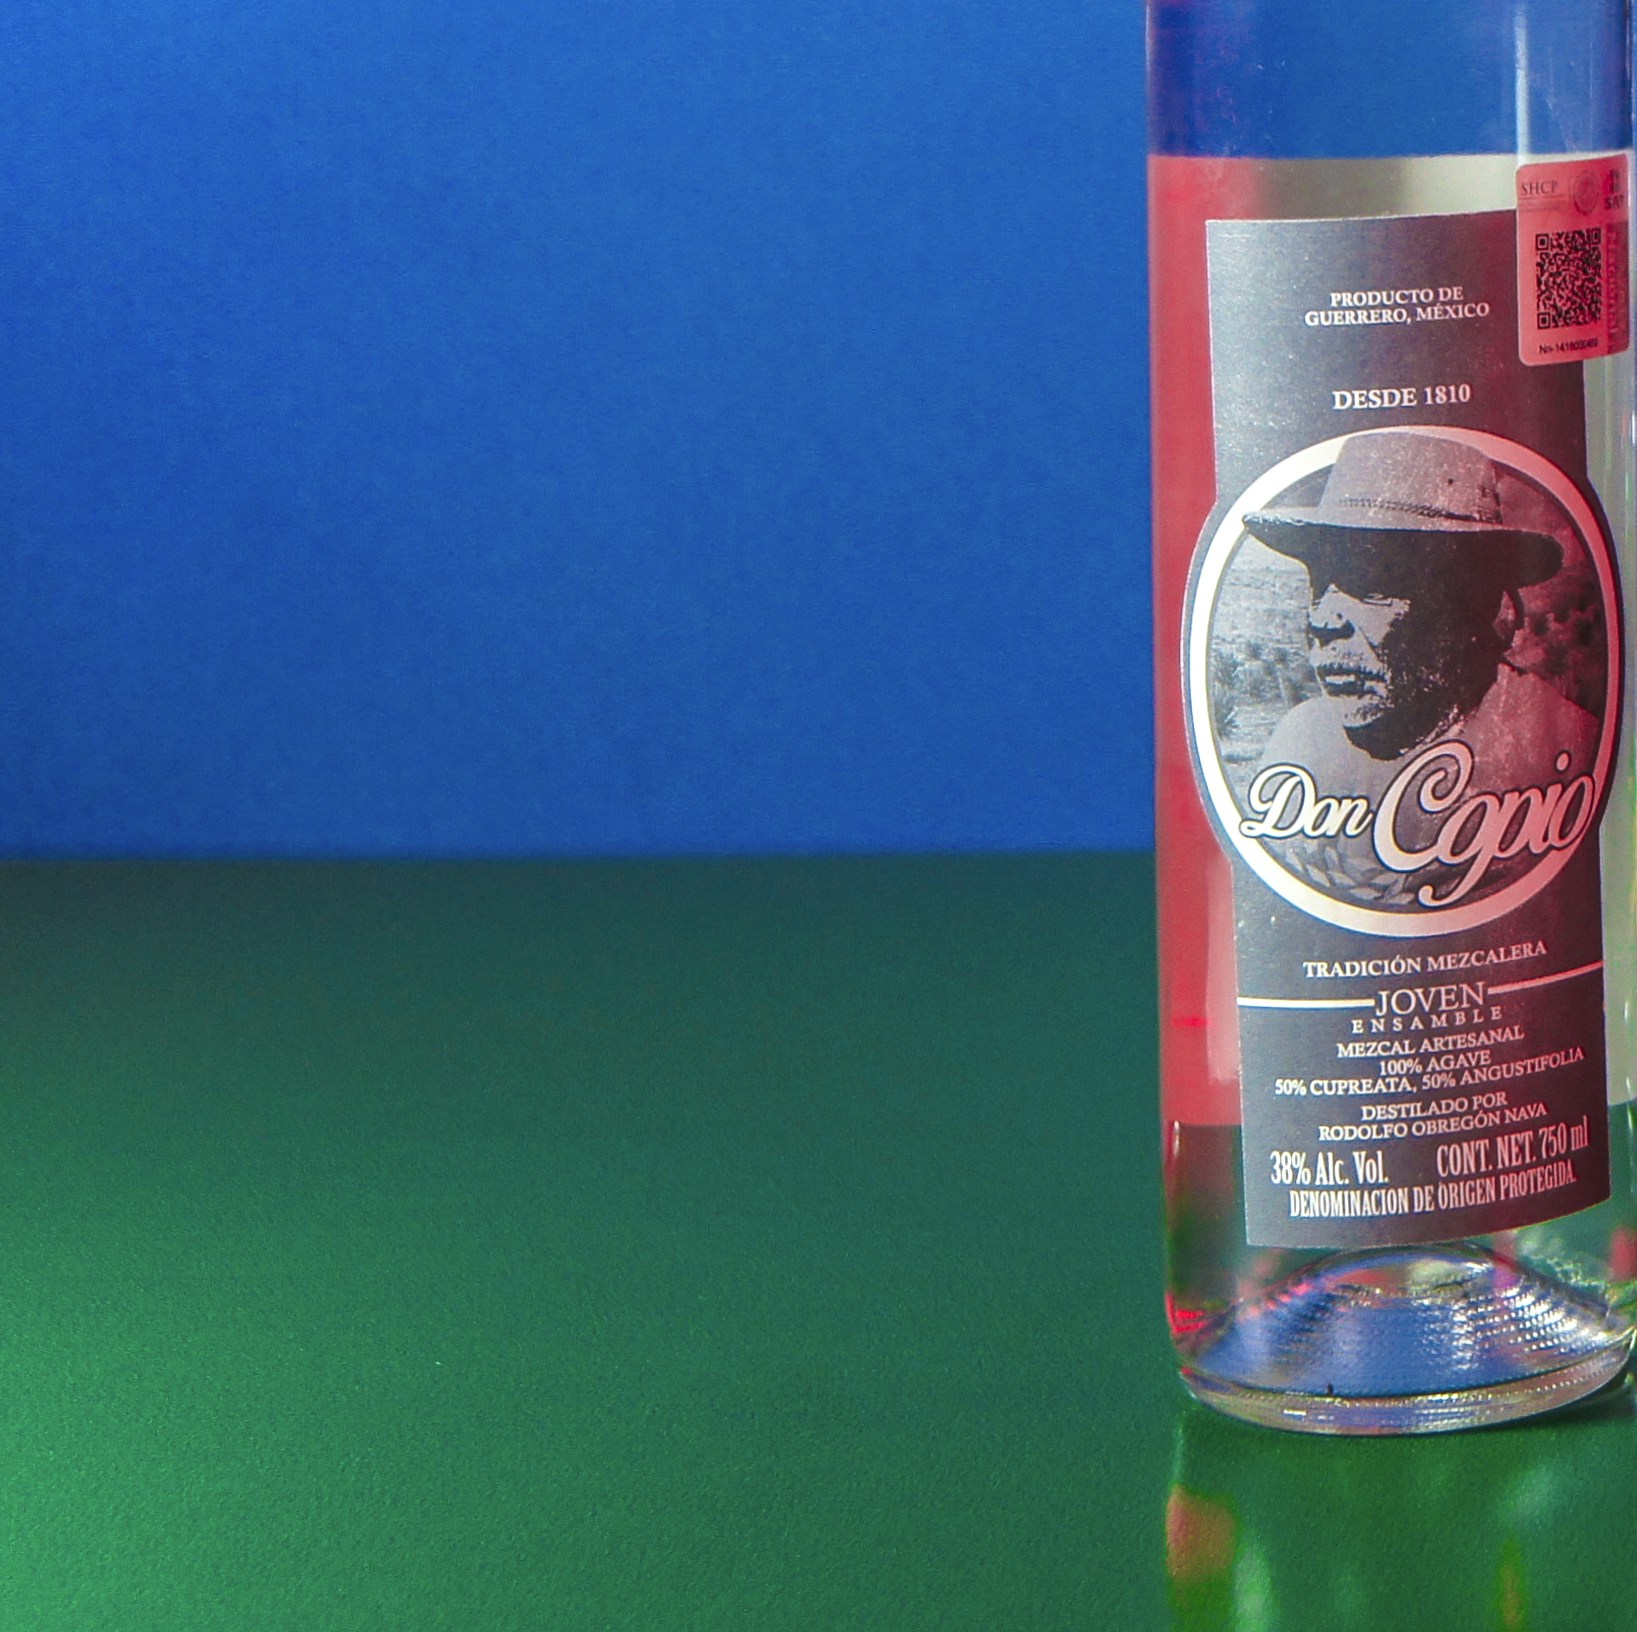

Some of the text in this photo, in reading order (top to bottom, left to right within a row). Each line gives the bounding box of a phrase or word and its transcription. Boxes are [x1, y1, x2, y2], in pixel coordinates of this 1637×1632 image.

[1521, 181, 1559, 196] SHCP
[1330, 286, 1464, 307] PRODUCTO DE
[1304, 302, 1490, 327] GUERRERO, MÉXICO
[1332, 384, 1471, 410] DESDE 1810
[1238, 762, 1374, 839] Don
[1302, 940, 1548, 978] TRADICIÓN MEZCALERA
[1375, 981, 1486, 1017] JOVEN
[1351, 1006, 1503, 1034] ENSAMBLE
[1336, 1024, 1525, 1058] MEZCAL ARTESANAL
[1275, 1046, 1585, 1097] 50% CUPREATA, 50% ANGUSTIFOLIA
[1379, 1049, 1492, 1076] 100% AGAVE
[1318, 1102, 1548, 1142] RODOLFO OBREGÓN NAVA
[1361, 1091, 1508, 1121] DESTILADO POR
[1269, 1114, 1589, 1186] 38% Alc. Vol. CONT. NET. 750 ml
[1289, 1187, 1409, 1218] DENOMINACION
[1413, 1184, 1435, 1213] DE
[1438, 1176, 1497, 1210] ORIGEN
